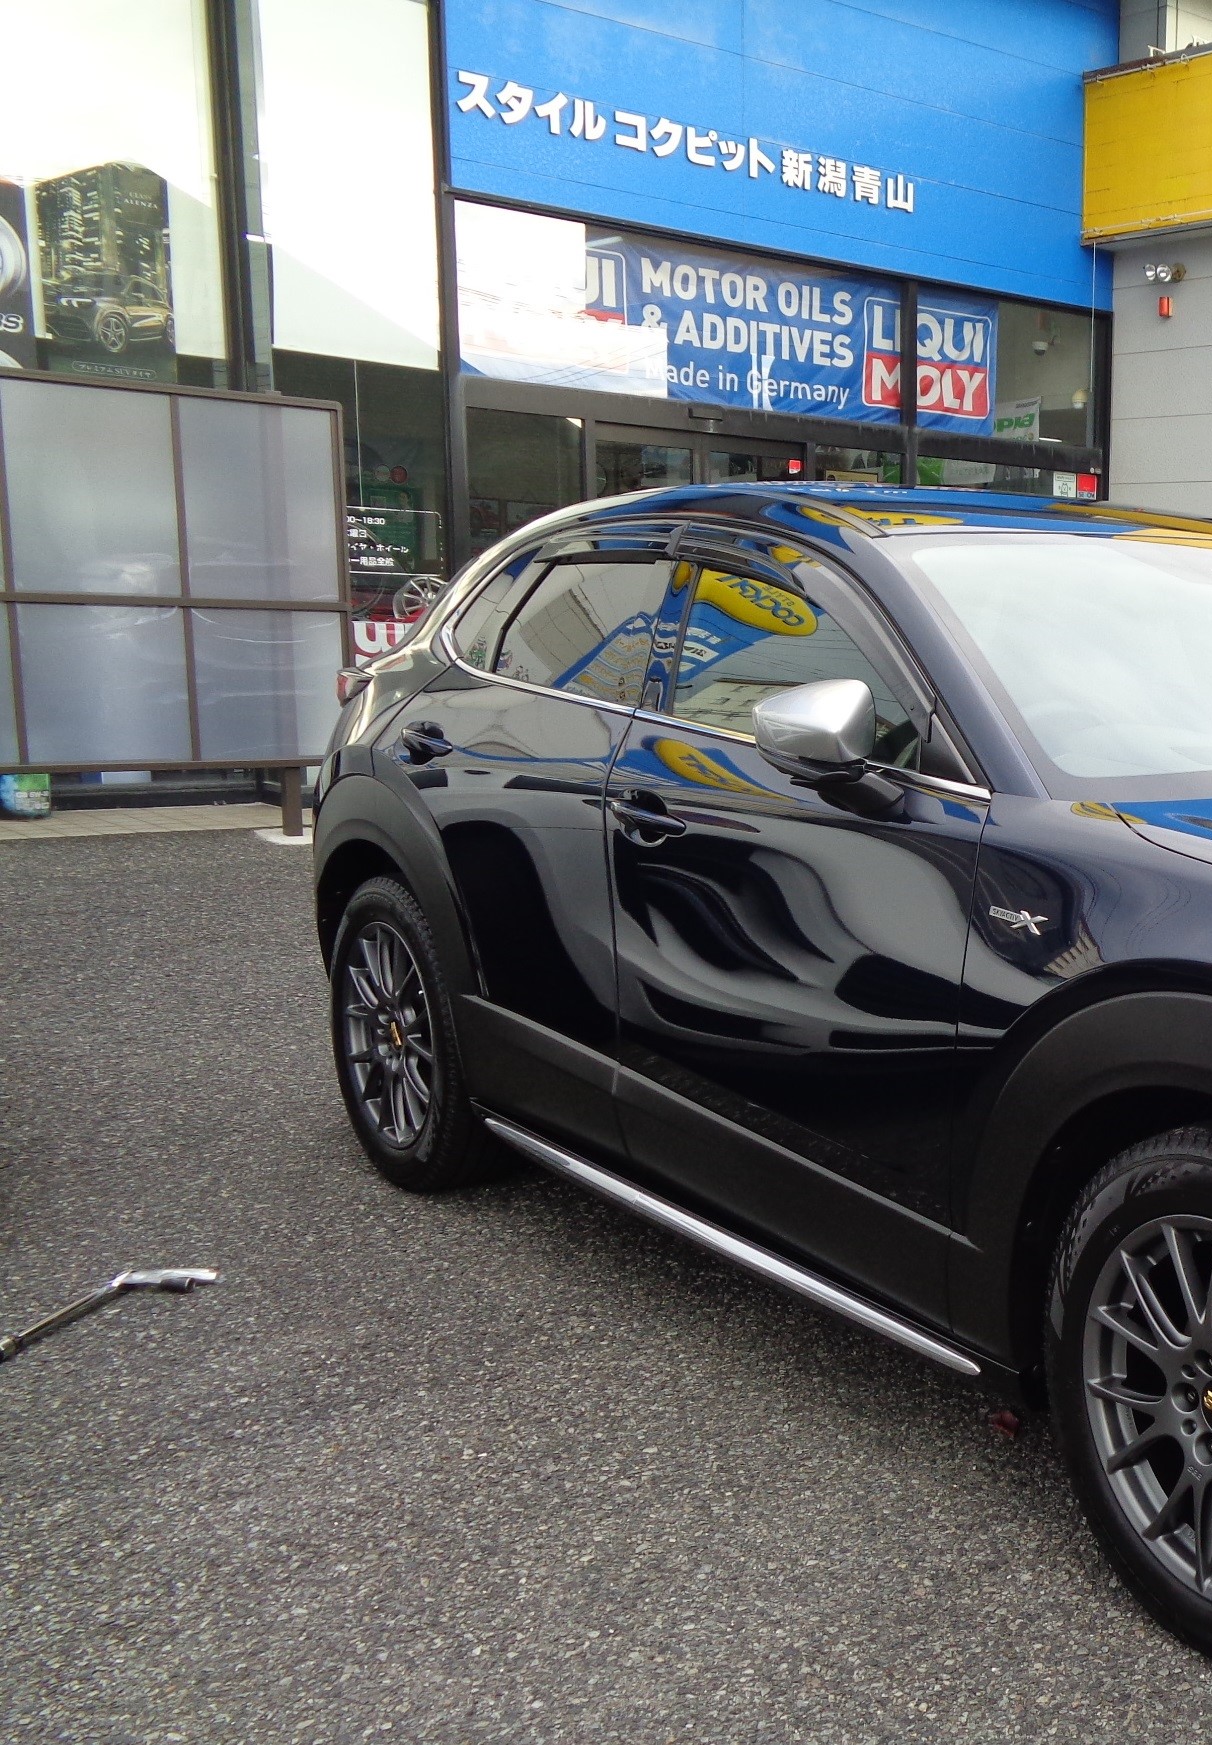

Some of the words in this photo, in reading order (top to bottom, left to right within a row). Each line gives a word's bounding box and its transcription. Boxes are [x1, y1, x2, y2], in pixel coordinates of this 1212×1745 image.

[456, 70, 606, 142] スタイル
[614, 110, 775, 179] コクピット
[781, 149, 915, 214] 新潟青山
[641, 257, 768, 312] MOTOR
[778, 282, 853, 326] OILS
[674, 313, 853, 368] ADDITIVES
[873, 305, 984, 363] LIQUI
[718, 365, 738, 393] in
[747, 370, 850, 411] Germany
[872, 358, 985, 412] MOLY
